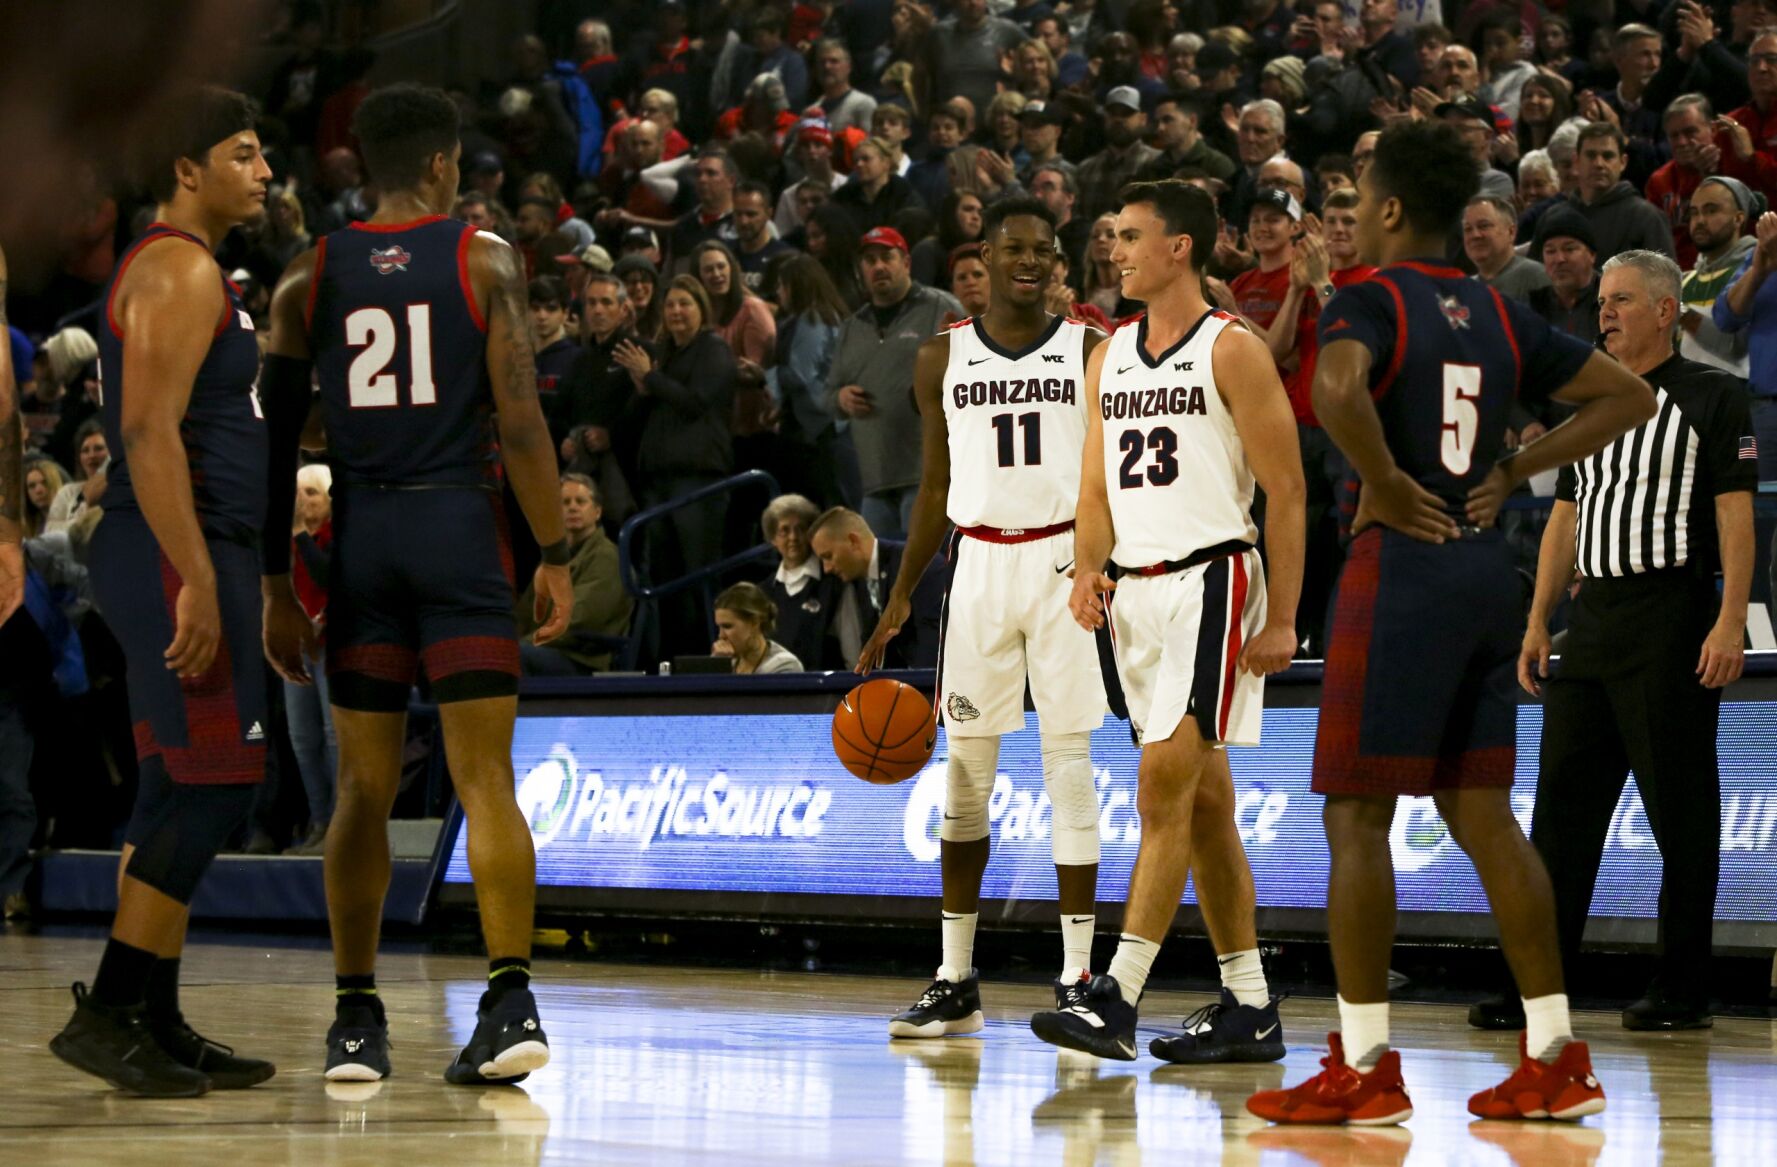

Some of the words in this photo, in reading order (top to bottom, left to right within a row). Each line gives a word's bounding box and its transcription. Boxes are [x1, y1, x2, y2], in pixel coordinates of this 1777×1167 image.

[344, 302, 437, 408] 21
[952, 378, 1076, 410] GONZAGA
[1101, 386, 1208, 421] GONZAGA
[1440, 361, 1483, 477] 5
[991, 411, 1042, 468] 11
[1119, 426, 1179, 490] 23
[569, 764, 832, 852] PacificSource
